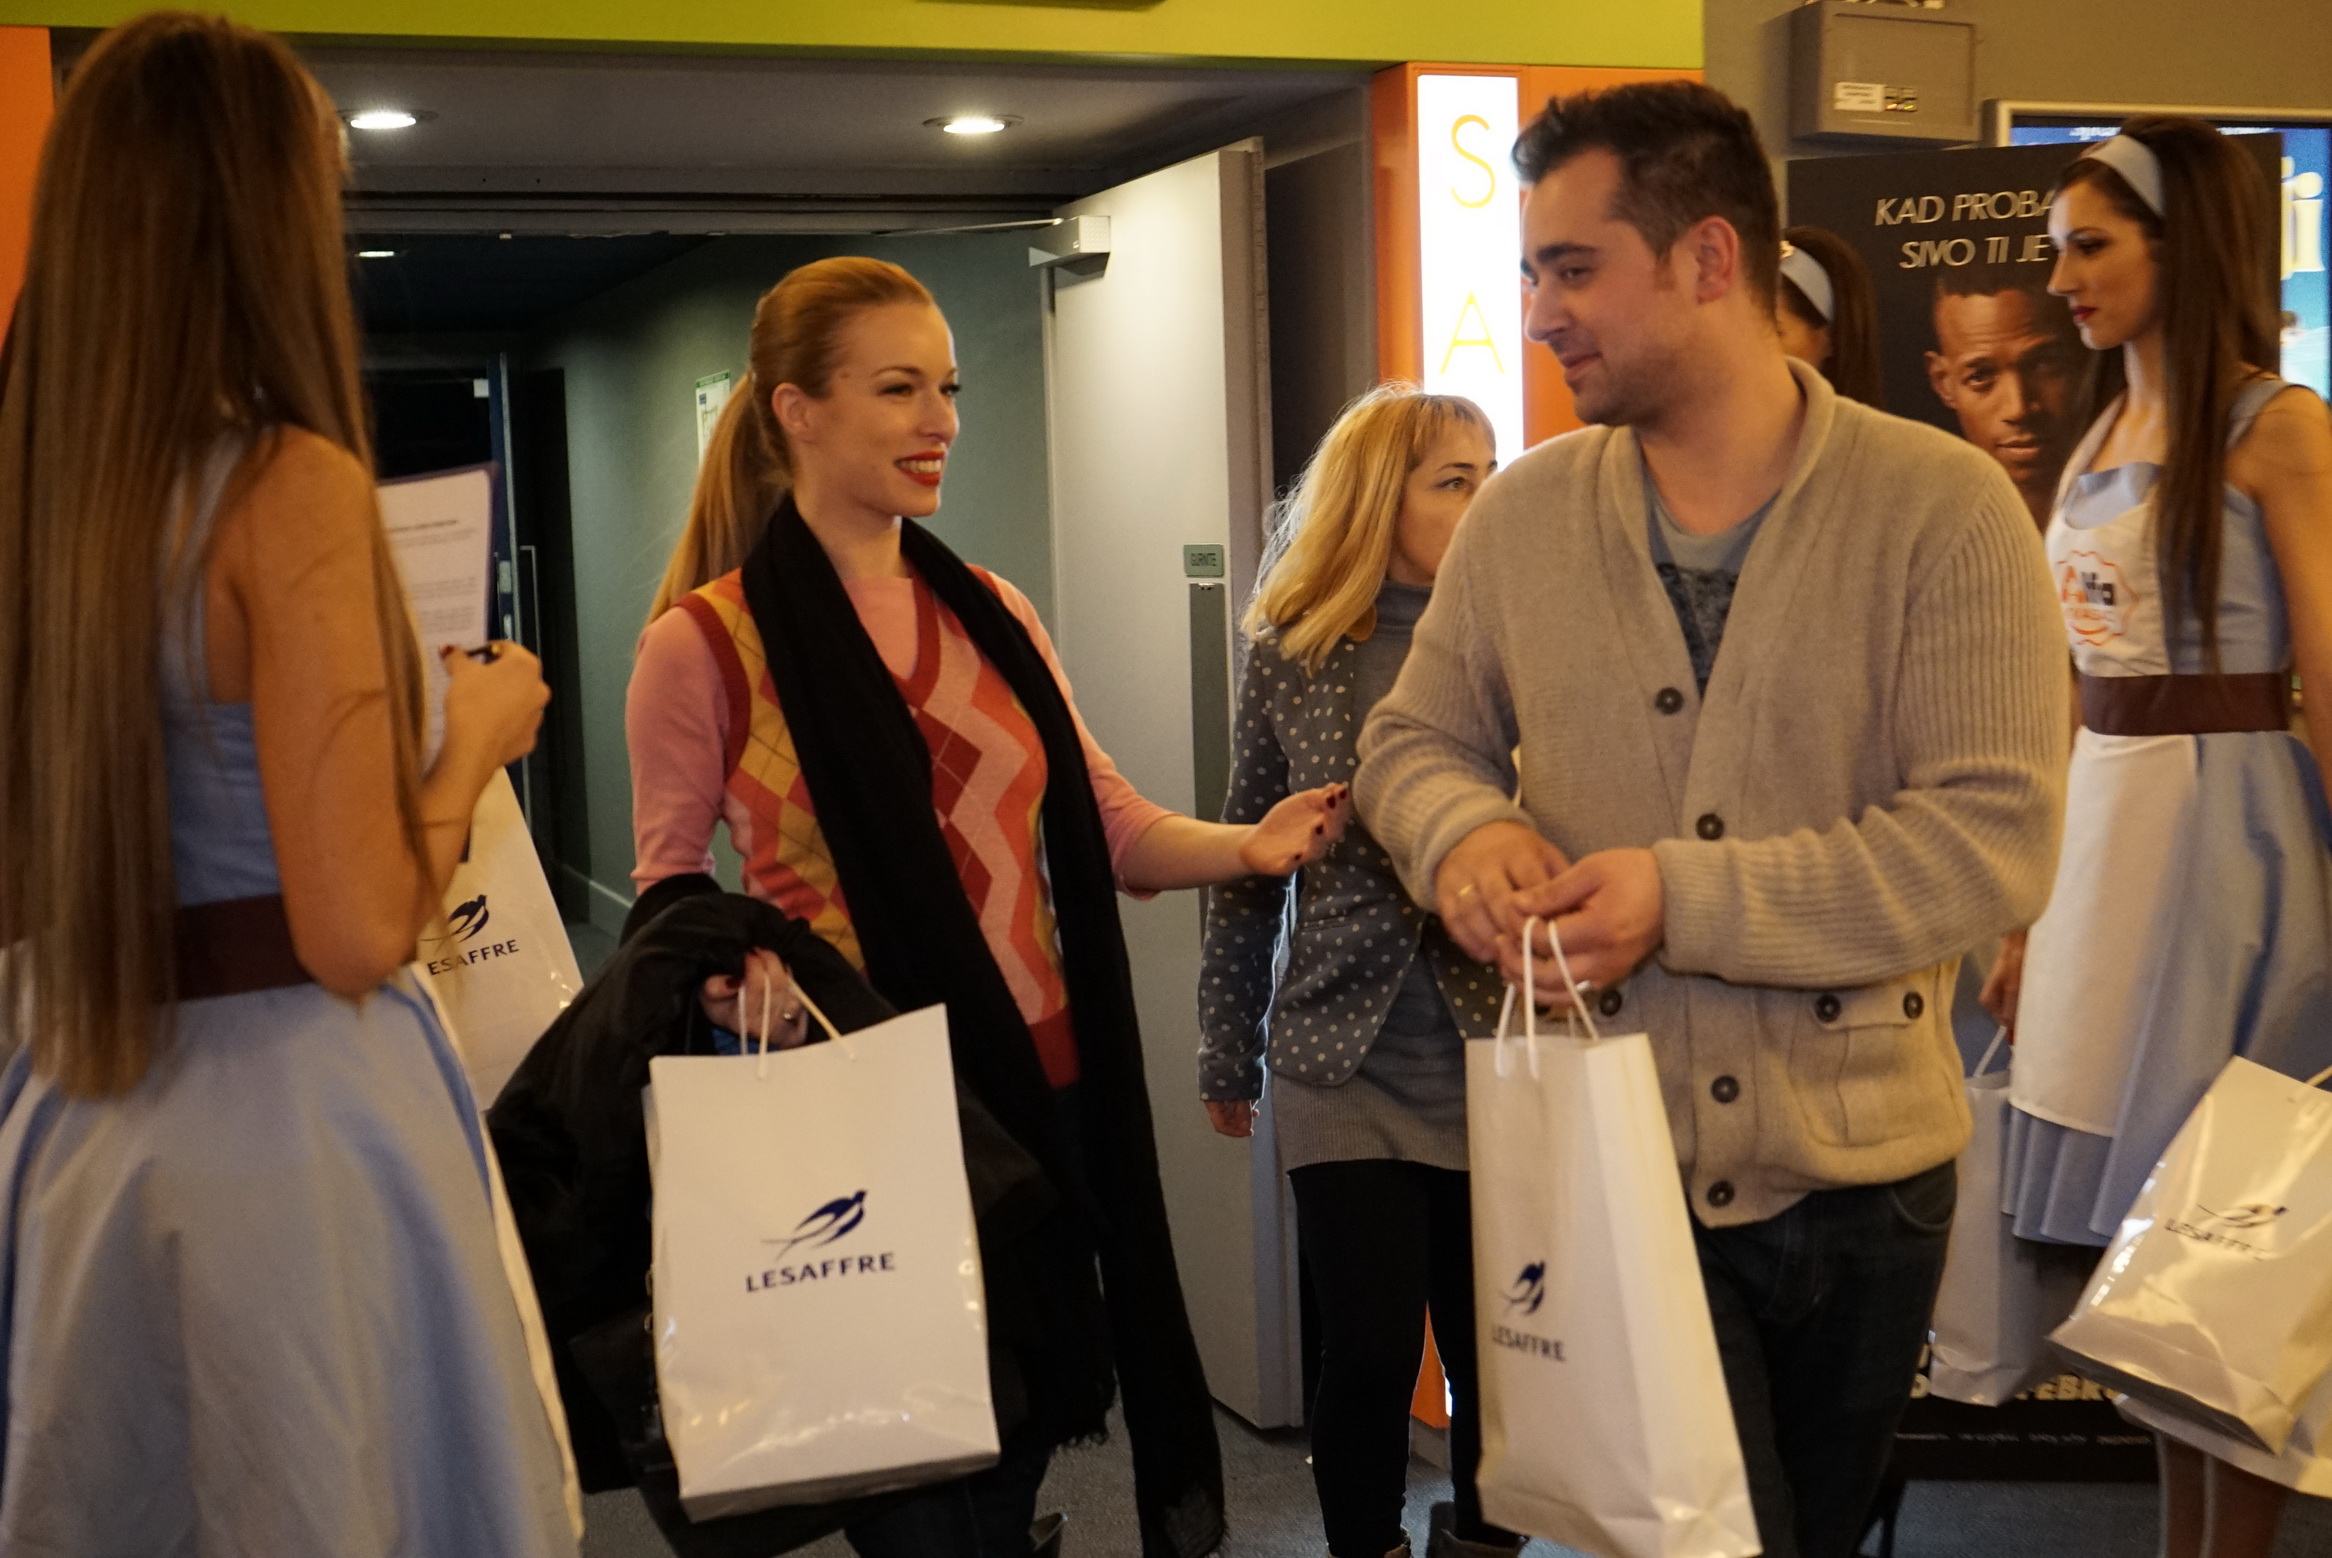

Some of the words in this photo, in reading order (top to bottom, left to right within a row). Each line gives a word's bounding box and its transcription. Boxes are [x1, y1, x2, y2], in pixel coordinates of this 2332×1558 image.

[1874, 195, 1946, 226] KAD
[1899, 238, 1976, 269] SIVO
[1985, 236, 2010, 264] TI
[2015, 233, 2050, 262] JE
[427, 939, 519, 976] ESAFFRE
[745, 1252, 896, 1293] LESAFFRE
